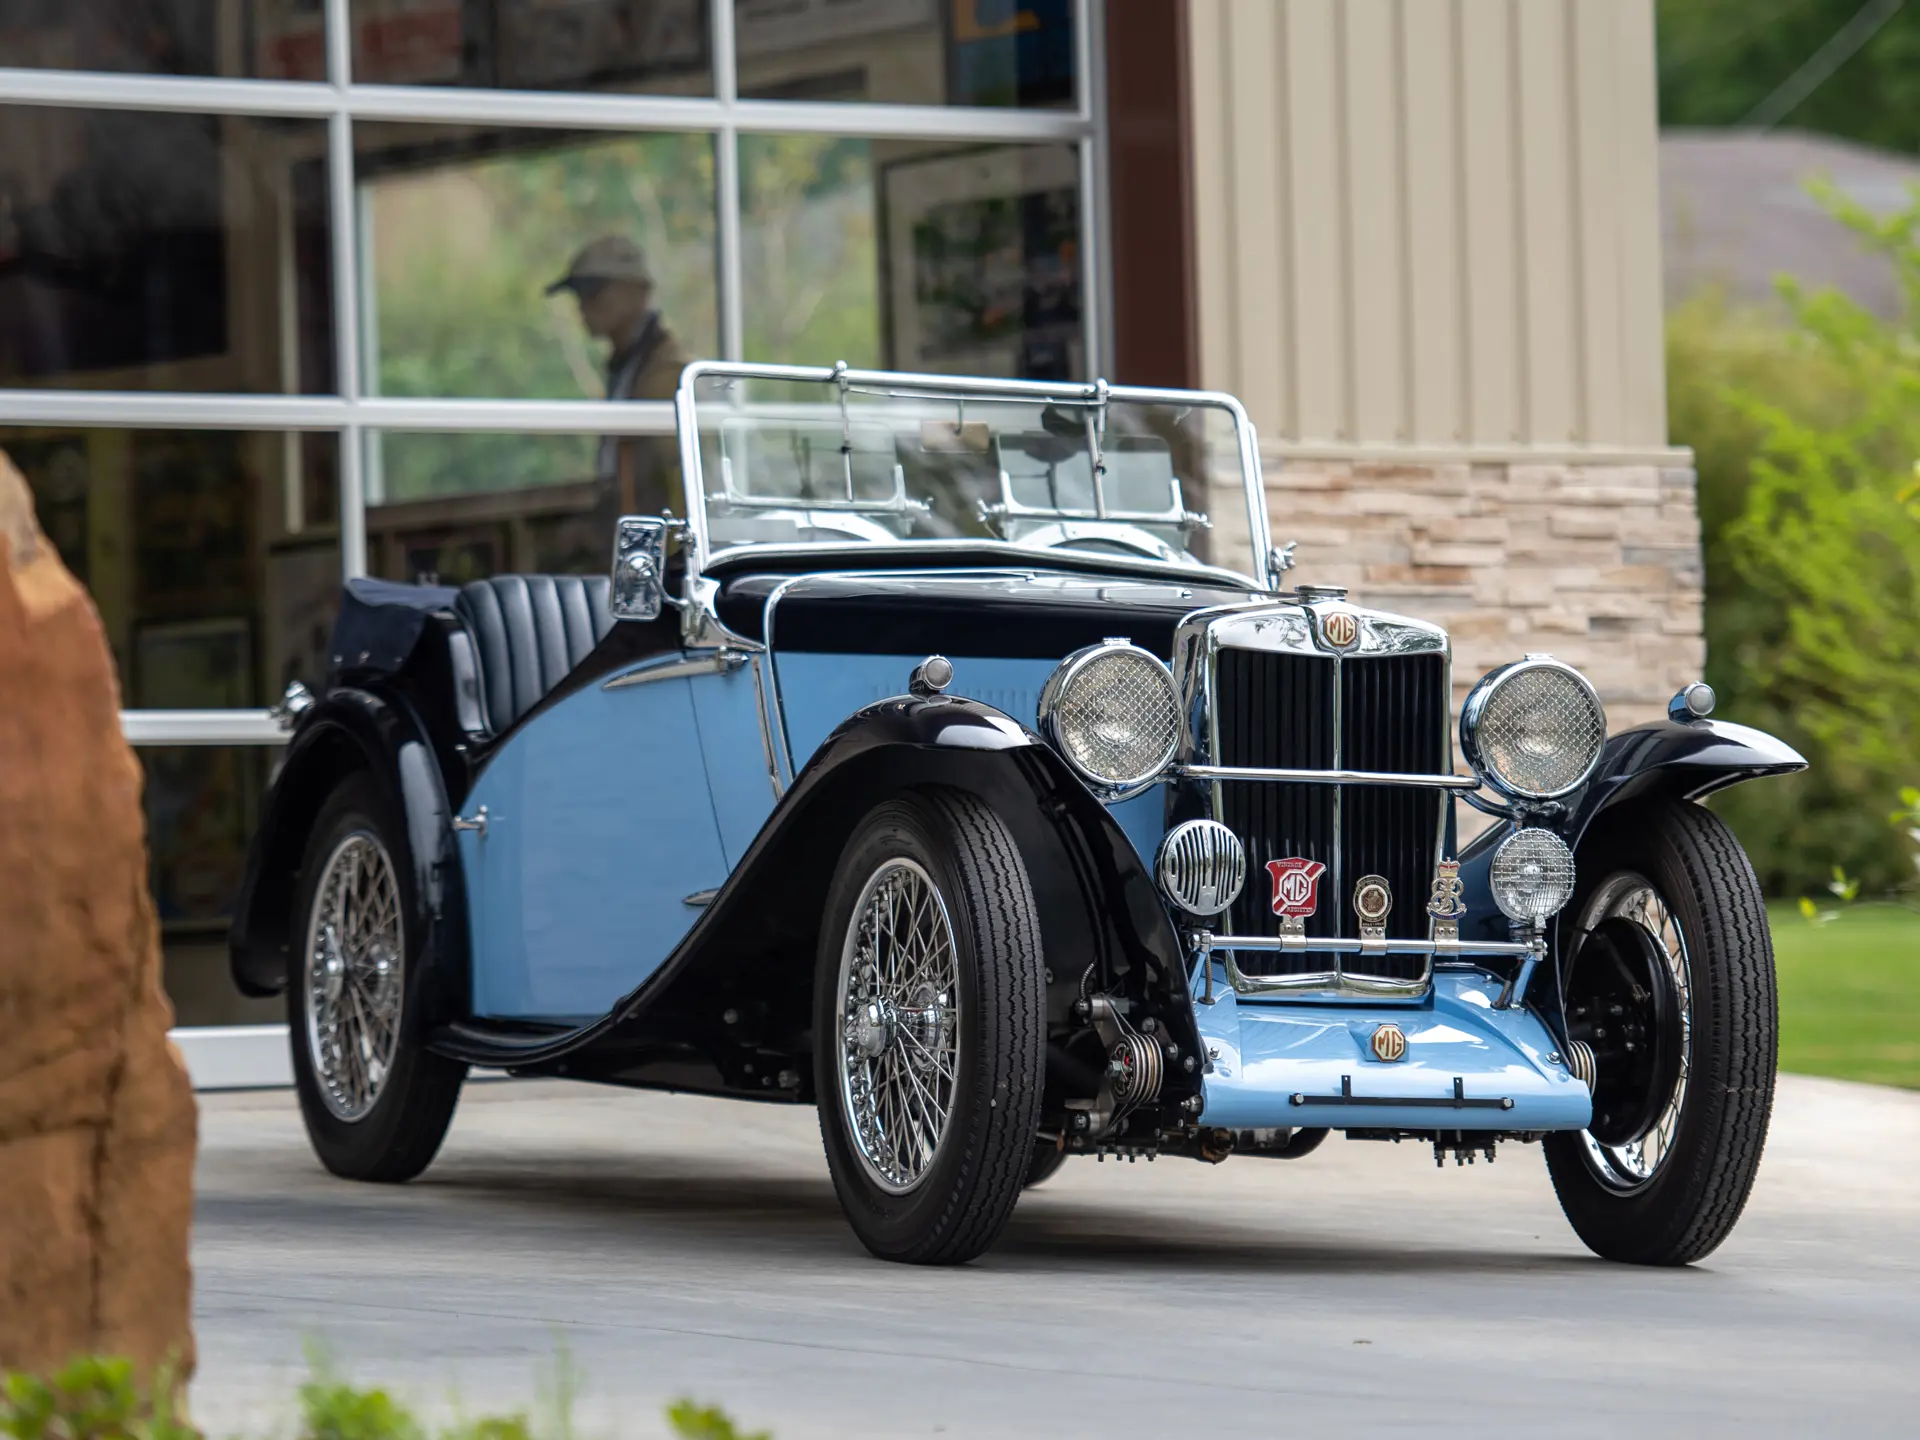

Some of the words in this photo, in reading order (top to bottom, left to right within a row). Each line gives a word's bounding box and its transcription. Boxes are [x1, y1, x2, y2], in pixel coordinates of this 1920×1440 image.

[1329, 615, 1354, 642] MG
[1283, 874, 1308, 901] MG
[1378, 1030, 1403, 1057] MG
